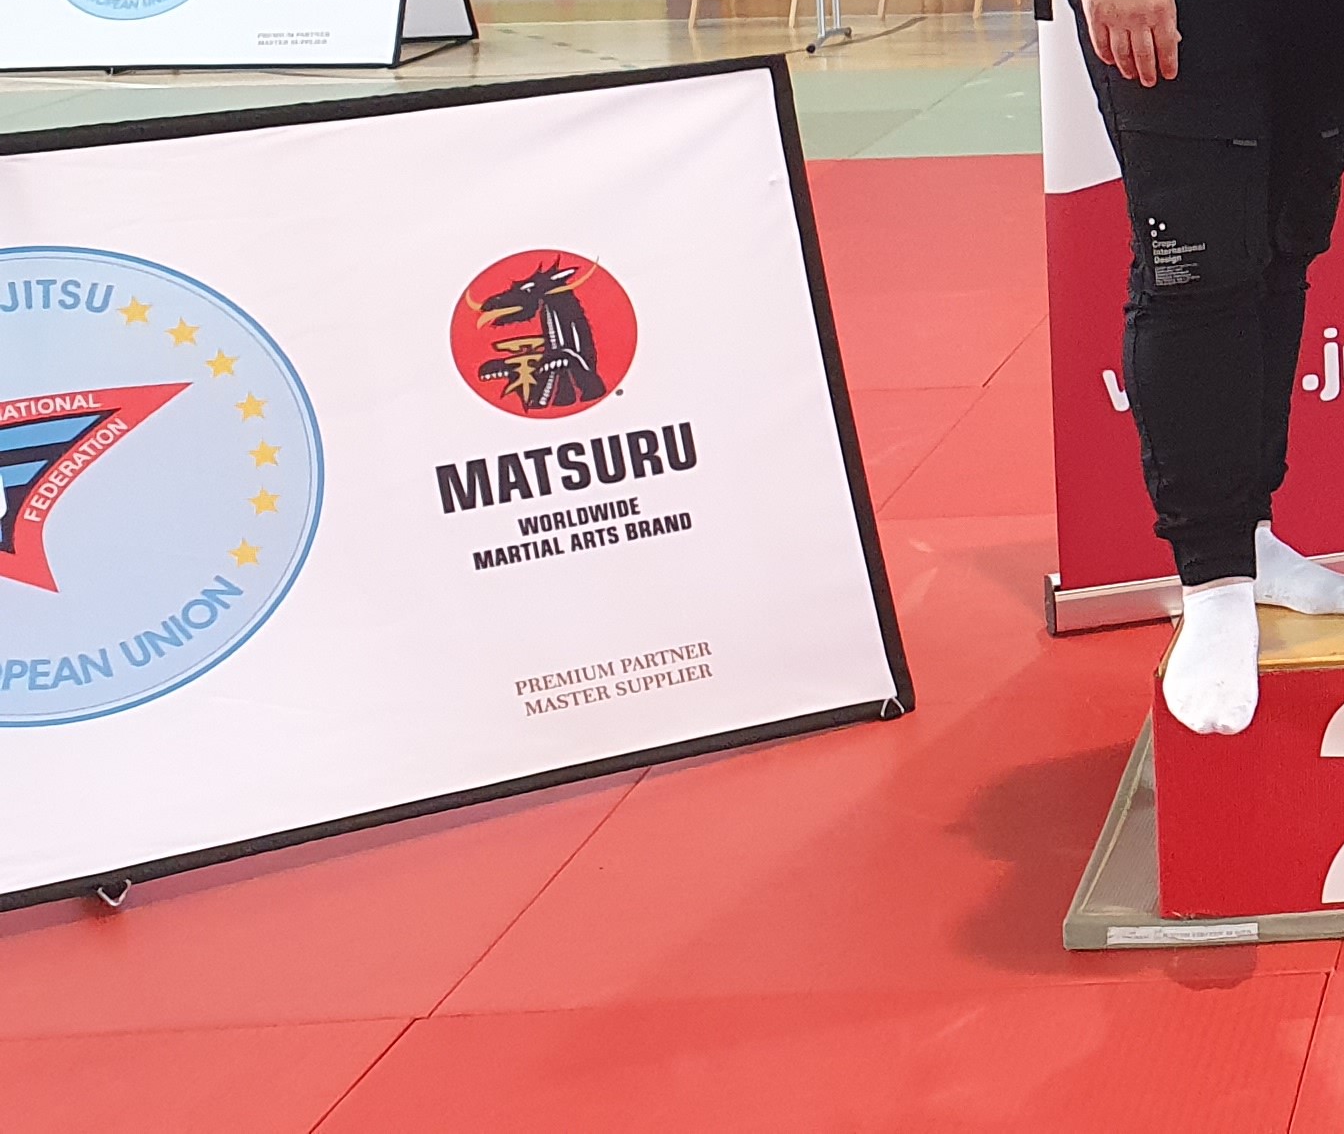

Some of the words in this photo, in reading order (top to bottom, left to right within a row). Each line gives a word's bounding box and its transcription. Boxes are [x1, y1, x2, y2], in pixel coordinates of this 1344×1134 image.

[0, 394, 102, 421] ATIONAL
[23, 417, 129, 522] FEDERATION
[436, 422, 698, 514] MATSURU
[473, 537, 565, 570] MARTIAL
[571, 526, 620, 552] ARTS
[625, 512, 692, 542] BRAND
[518, 497, 641, 537] WORLDWIDE
[0, 648, 114, 691] PEAN
[119, 575, 244, 668] UNION
[515, 661, 615, 696] PREMIUM
[620, 641, 713, 674] PARTNER
[524, 685, 611, 717] MASTER
[616, 663, 713, 697] SUPPLIER
